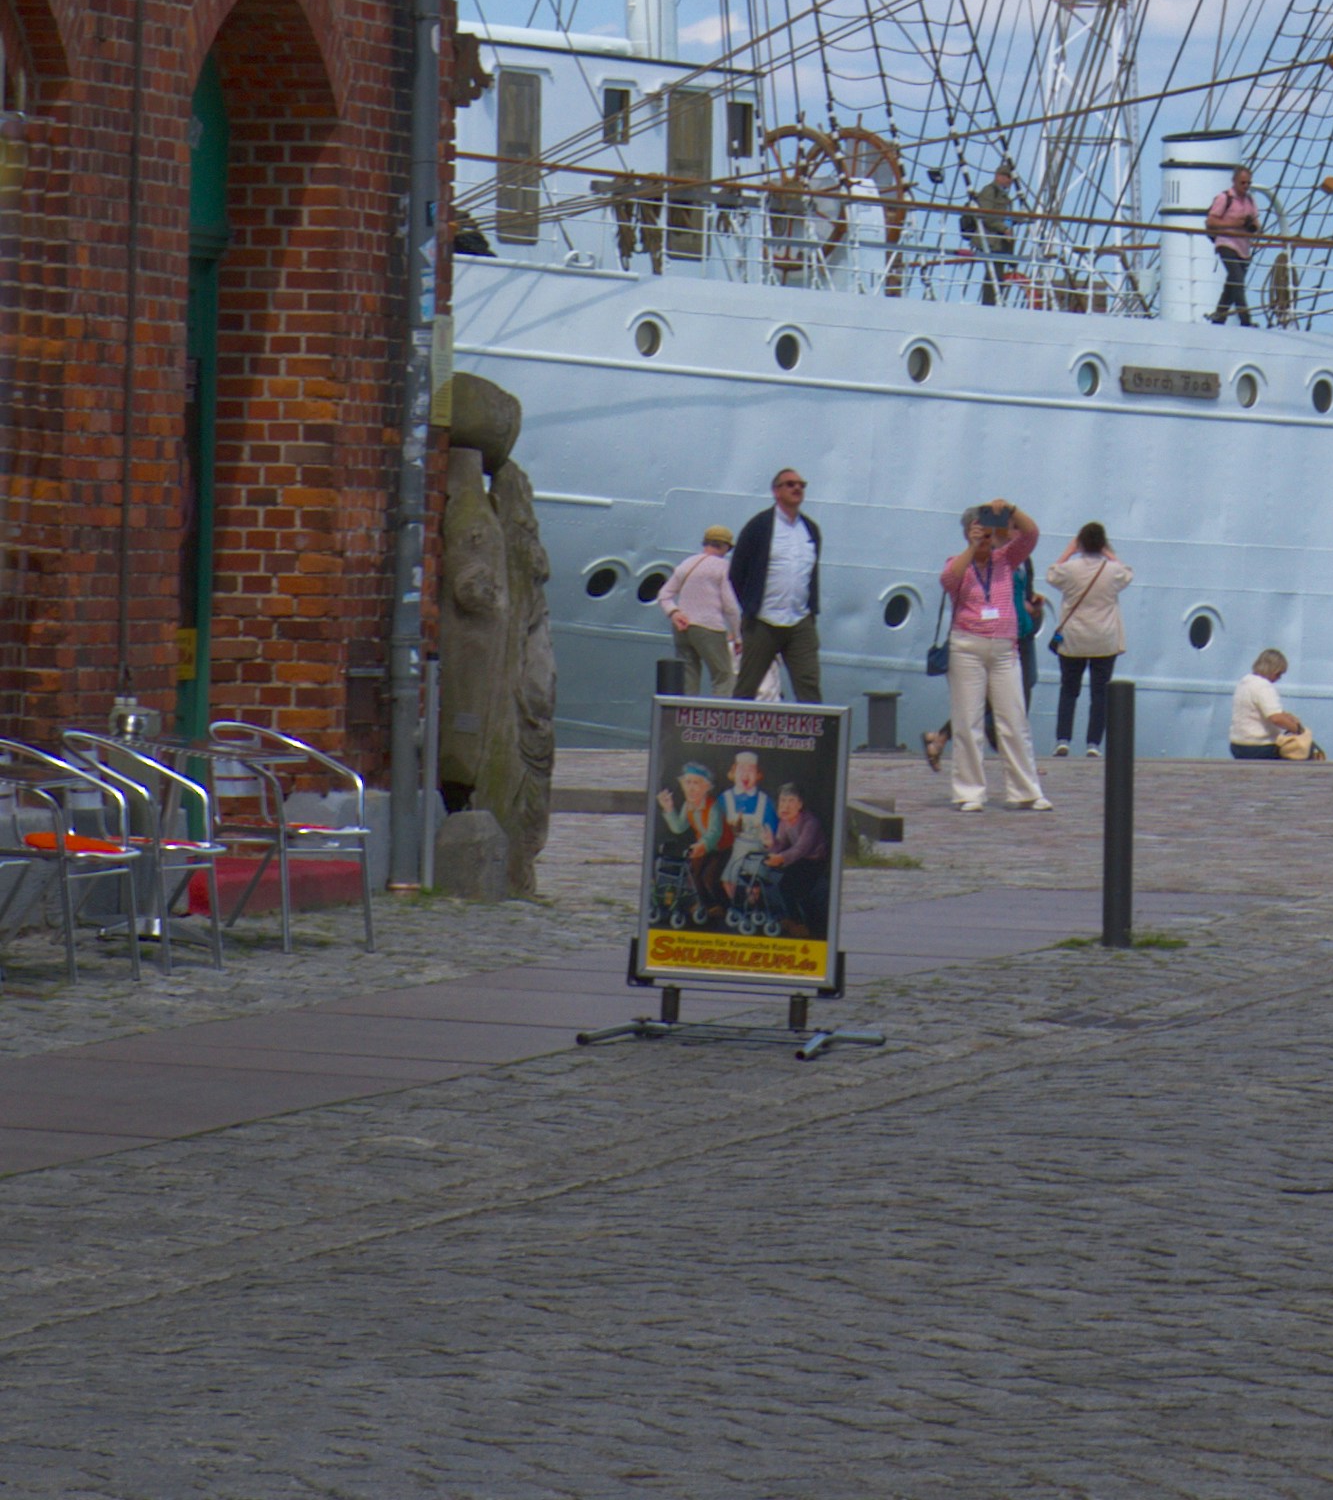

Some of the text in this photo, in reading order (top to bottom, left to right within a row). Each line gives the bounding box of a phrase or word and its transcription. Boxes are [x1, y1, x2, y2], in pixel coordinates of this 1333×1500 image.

[675, 707, 824, 736] MEISTERWERKE
[682, 729, 816, 750] der Komischen Kunst
